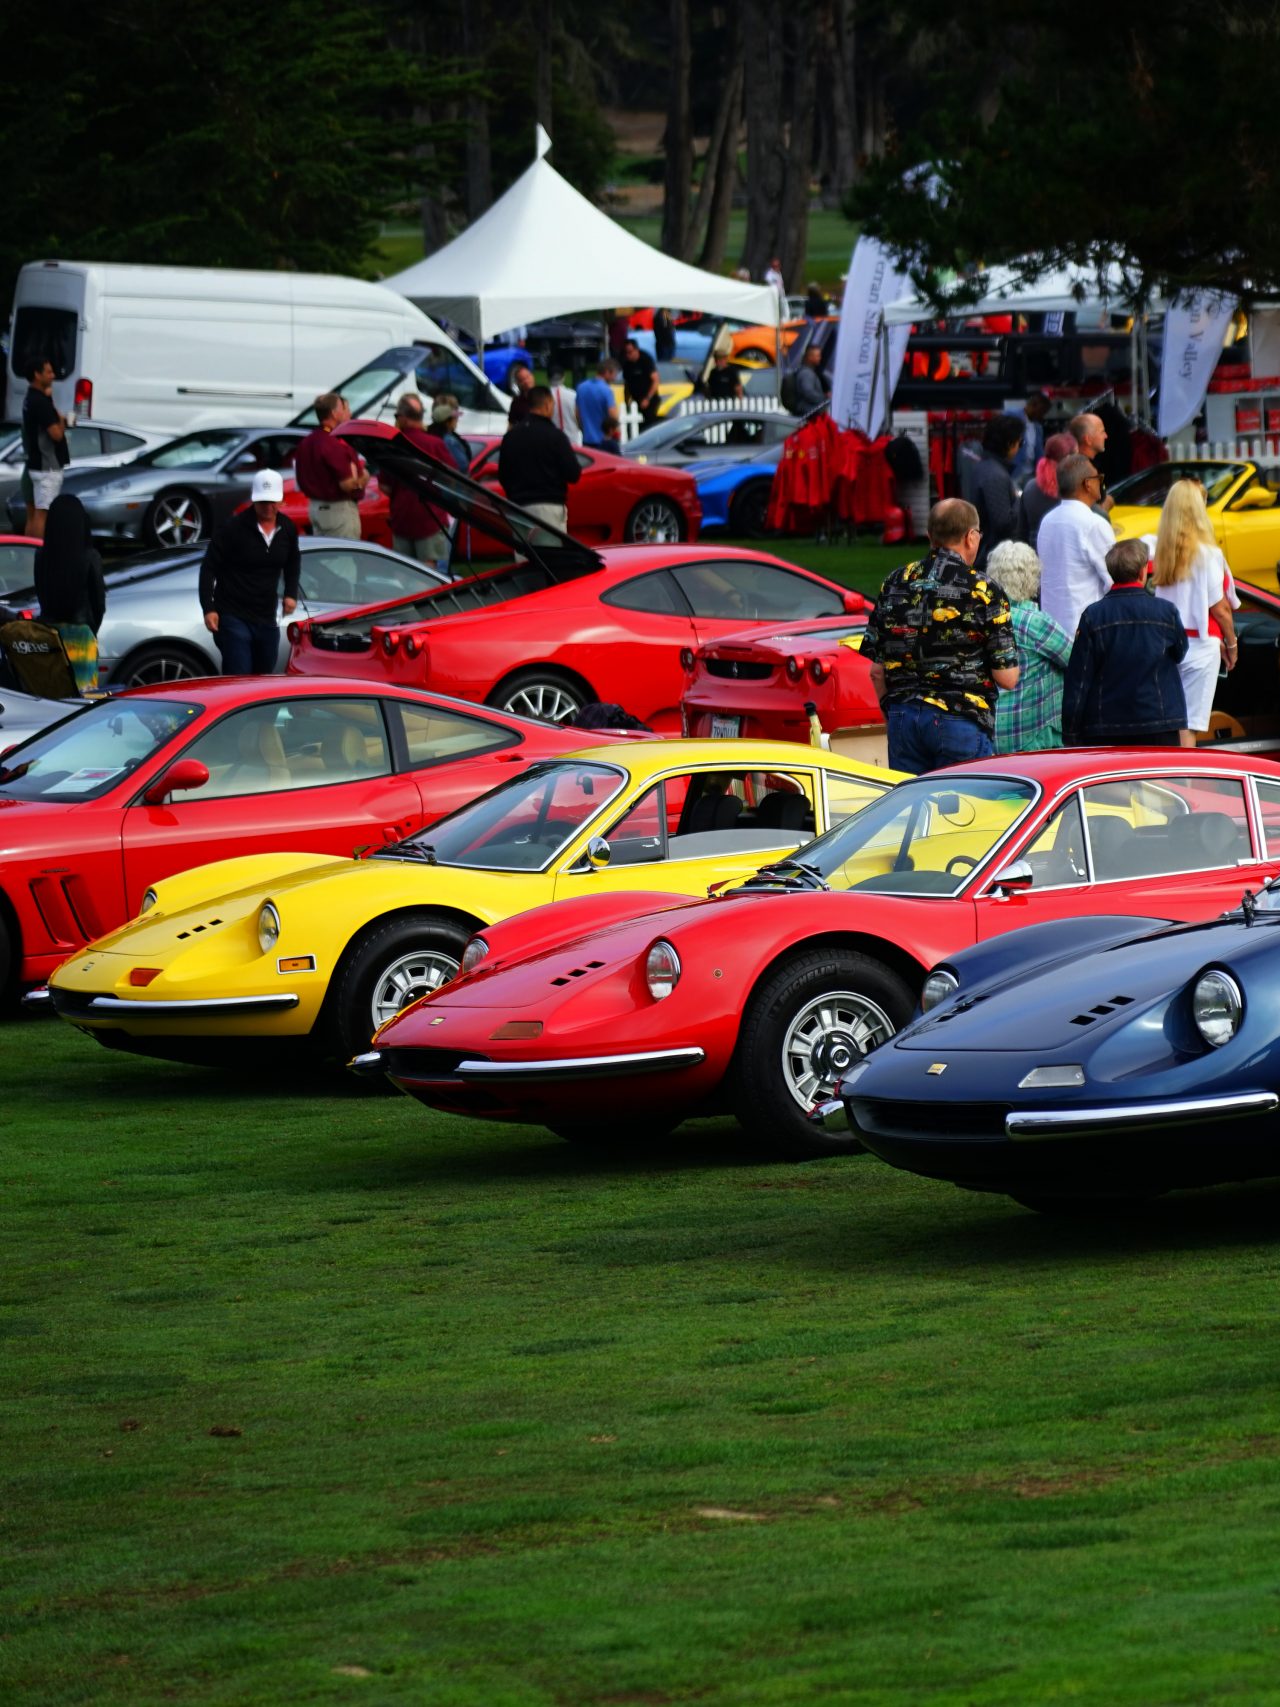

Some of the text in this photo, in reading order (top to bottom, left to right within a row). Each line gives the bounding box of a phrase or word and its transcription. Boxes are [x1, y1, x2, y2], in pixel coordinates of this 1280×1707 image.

[1179, 330, 1205, 381] Valley
[847, 371, 872, 422] Valley
[779, 962, 838, 1004] MICHELIN
